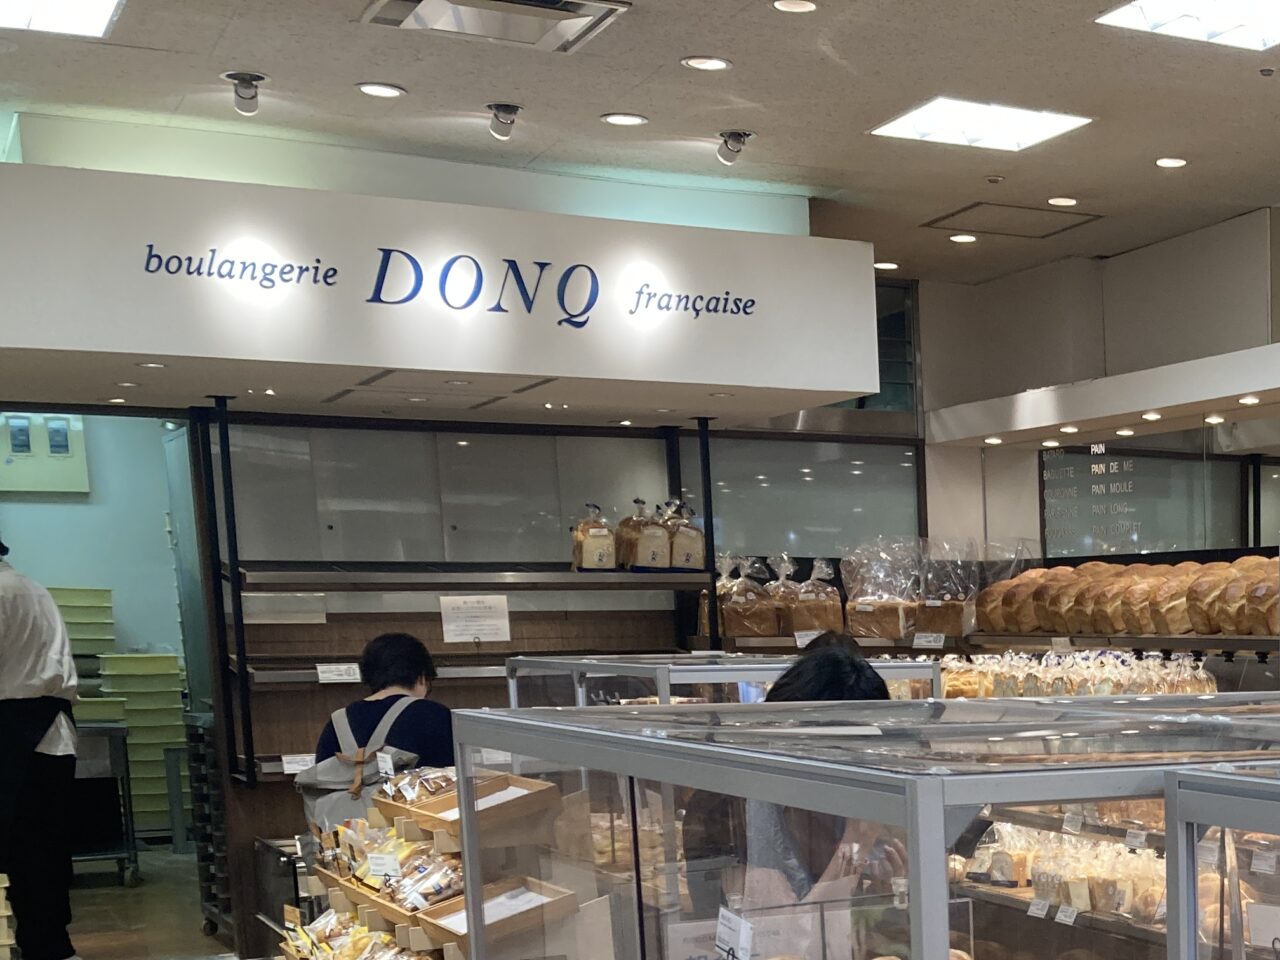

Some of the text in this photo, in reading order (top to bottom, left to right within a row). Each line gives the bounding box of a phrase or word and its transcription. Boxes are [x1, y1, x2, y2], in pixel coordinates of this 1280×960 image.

[144, 245, 757, 328] boulangerie DONQ française
[1091, 444, 1105, 455] PAIN
[1091, 464, 1105, 475] PAIN
[1110, 462, 1119, 472] DE
[1091, 484, 1105, 495] PAIN
